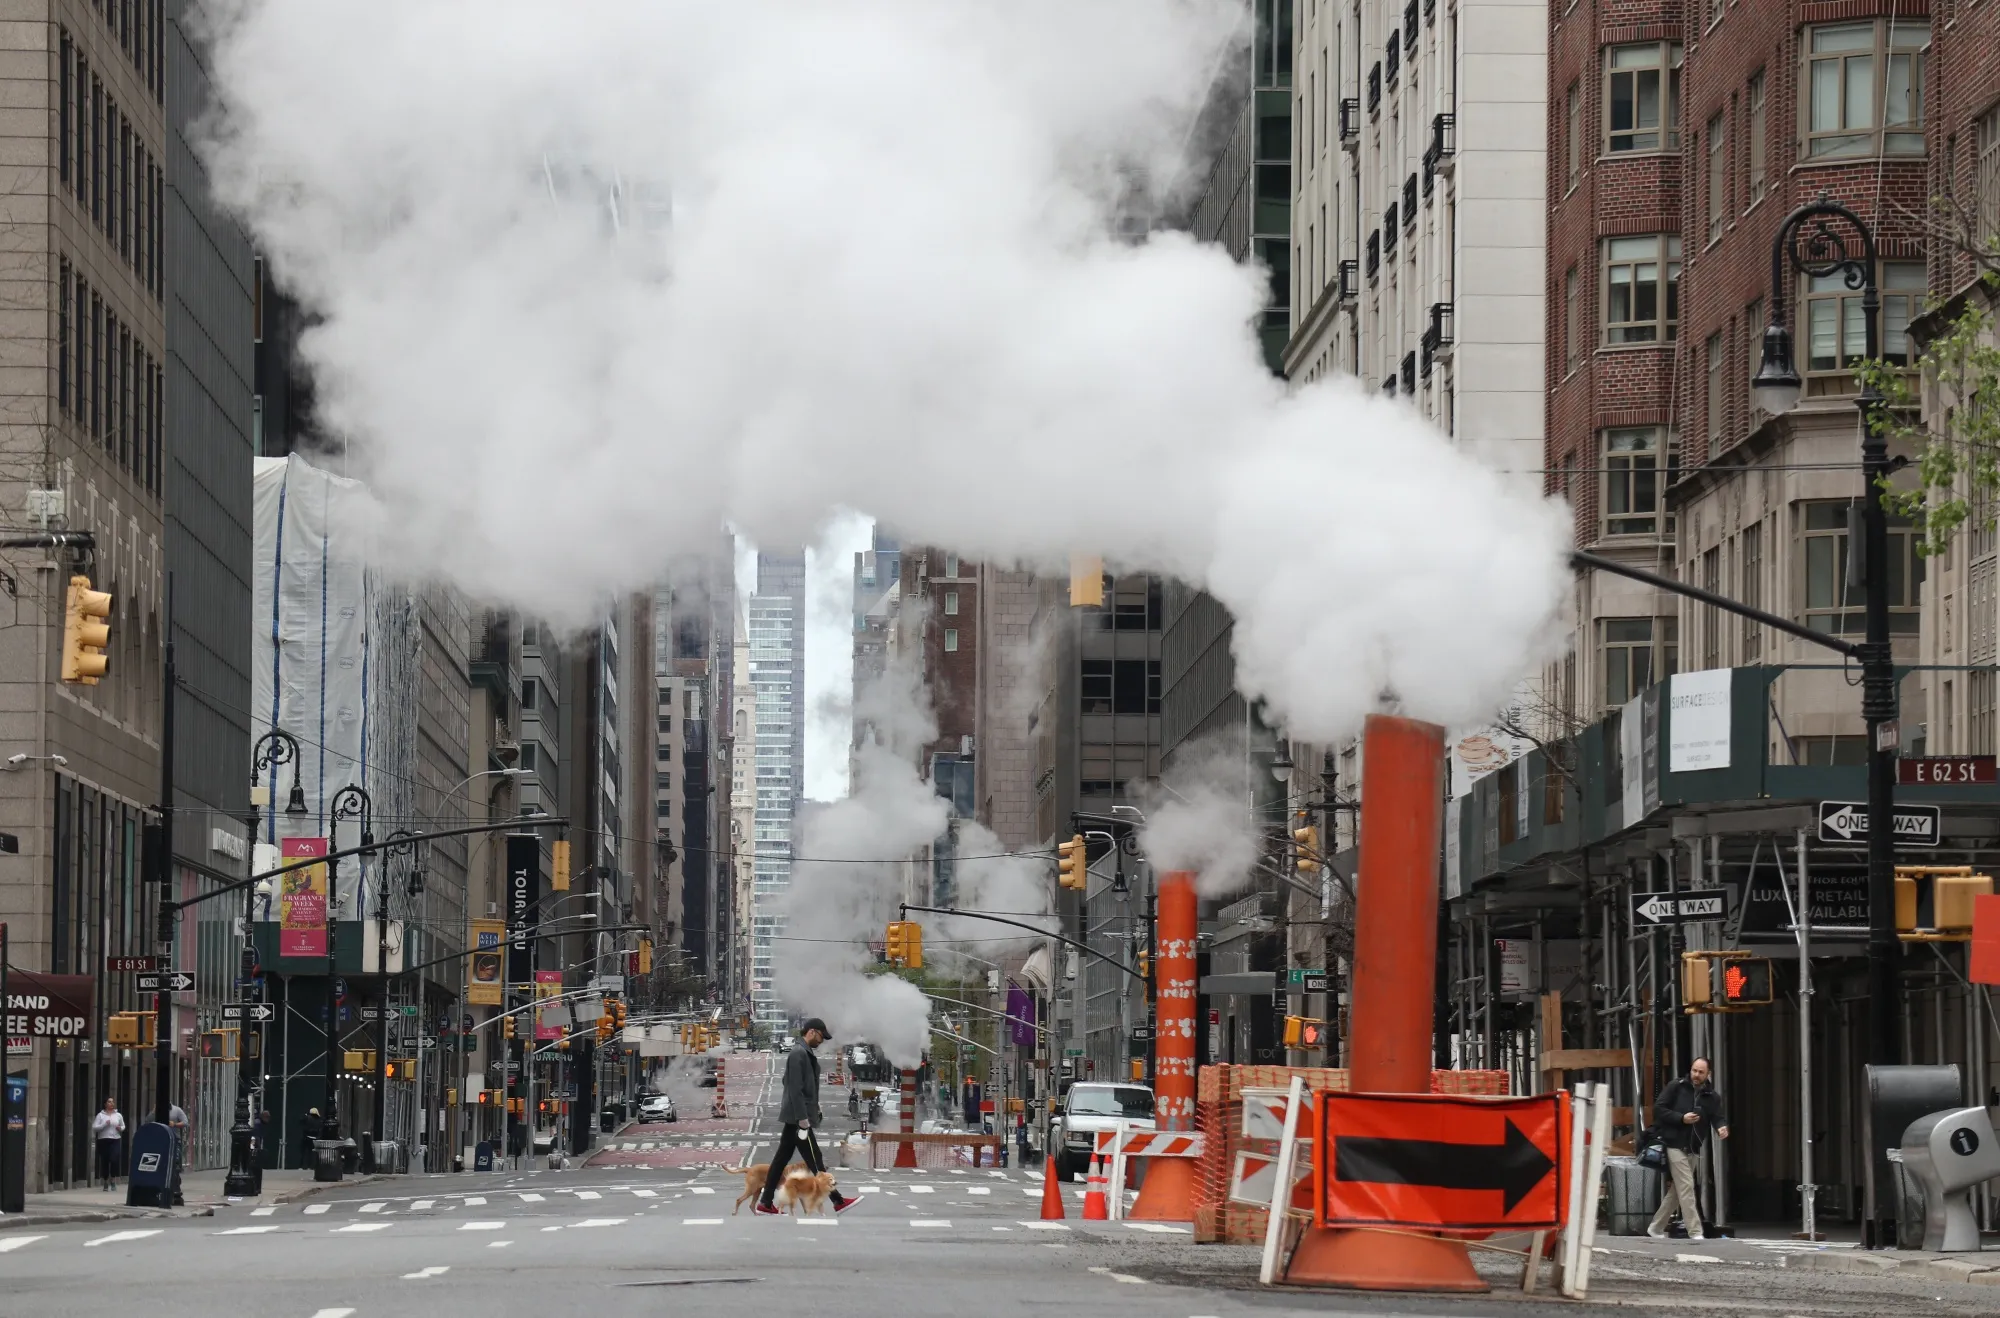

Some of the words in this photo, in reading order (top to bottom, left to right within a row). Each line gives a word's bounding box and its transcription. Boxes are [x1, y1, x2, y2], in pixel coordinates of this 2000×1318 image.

[1916, 763, 1924, 782] E
[1932, 763, 1952, 782] 62
[1959, 762, 1976, 782] St
[1836, 814, 1869, 830] ONE
[1893, 816, 1927, 833] WAY
[1840, 876, 1869, 886] EQUIT
[1816, 890, 1868, 902] RETAIL
[1649, 902, 1676, 916] ONE
[1686, 900, 1715, 913] WAY
[117, 959, 122, 970] E
[125, 959, 135, 970] 61
[137, 959, 147, 970] St
[1292, 971, 1297, 981] E
[1311, 980, 1327, 988] ONE
[3, 1014, 28, 1034] EE
[34, 1016, 85, 1035] SHOP
[1016, 1005, 1027, 1038] Bonams
[1038, 1020, 1046, 1043] FEDI
[7, 1036, 31, 1047] ATM
[13, 1088, 22, 1101] P
